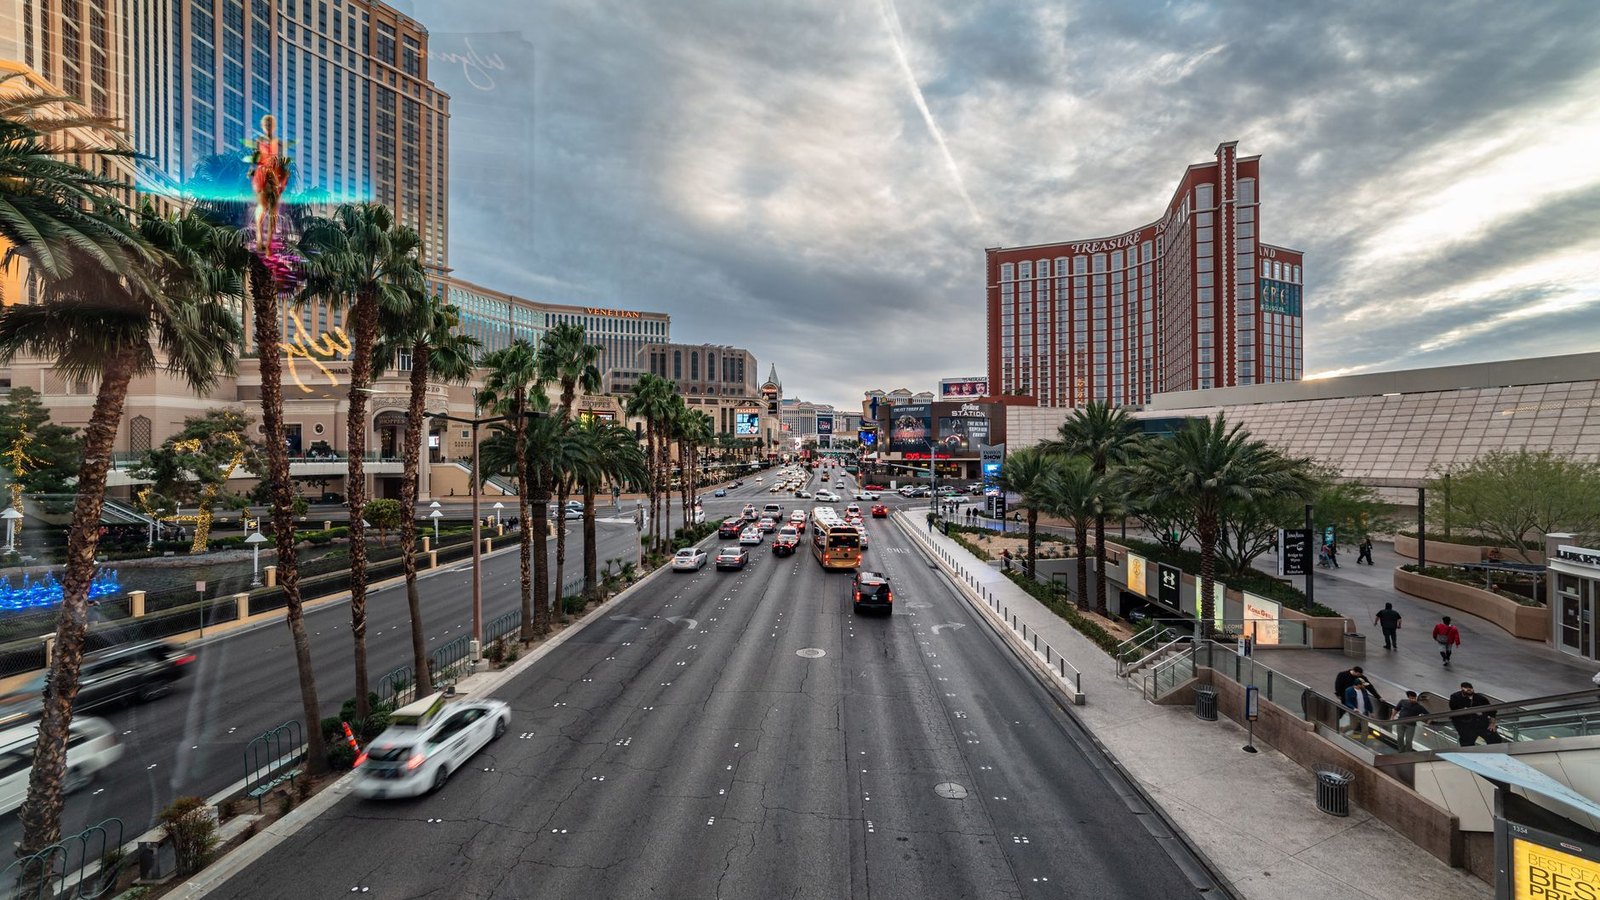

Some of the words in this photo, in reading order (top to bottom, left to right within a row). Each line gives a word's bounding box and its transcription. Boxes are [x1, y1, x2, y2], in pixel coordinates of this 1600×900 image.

[1071, 231, 1141, 254] TREASURE
[586, 307, 641, 318] VENETIAN
[1512, 825, 1528, 834] 1354
[1528, 853, 1566, 874] BEST
